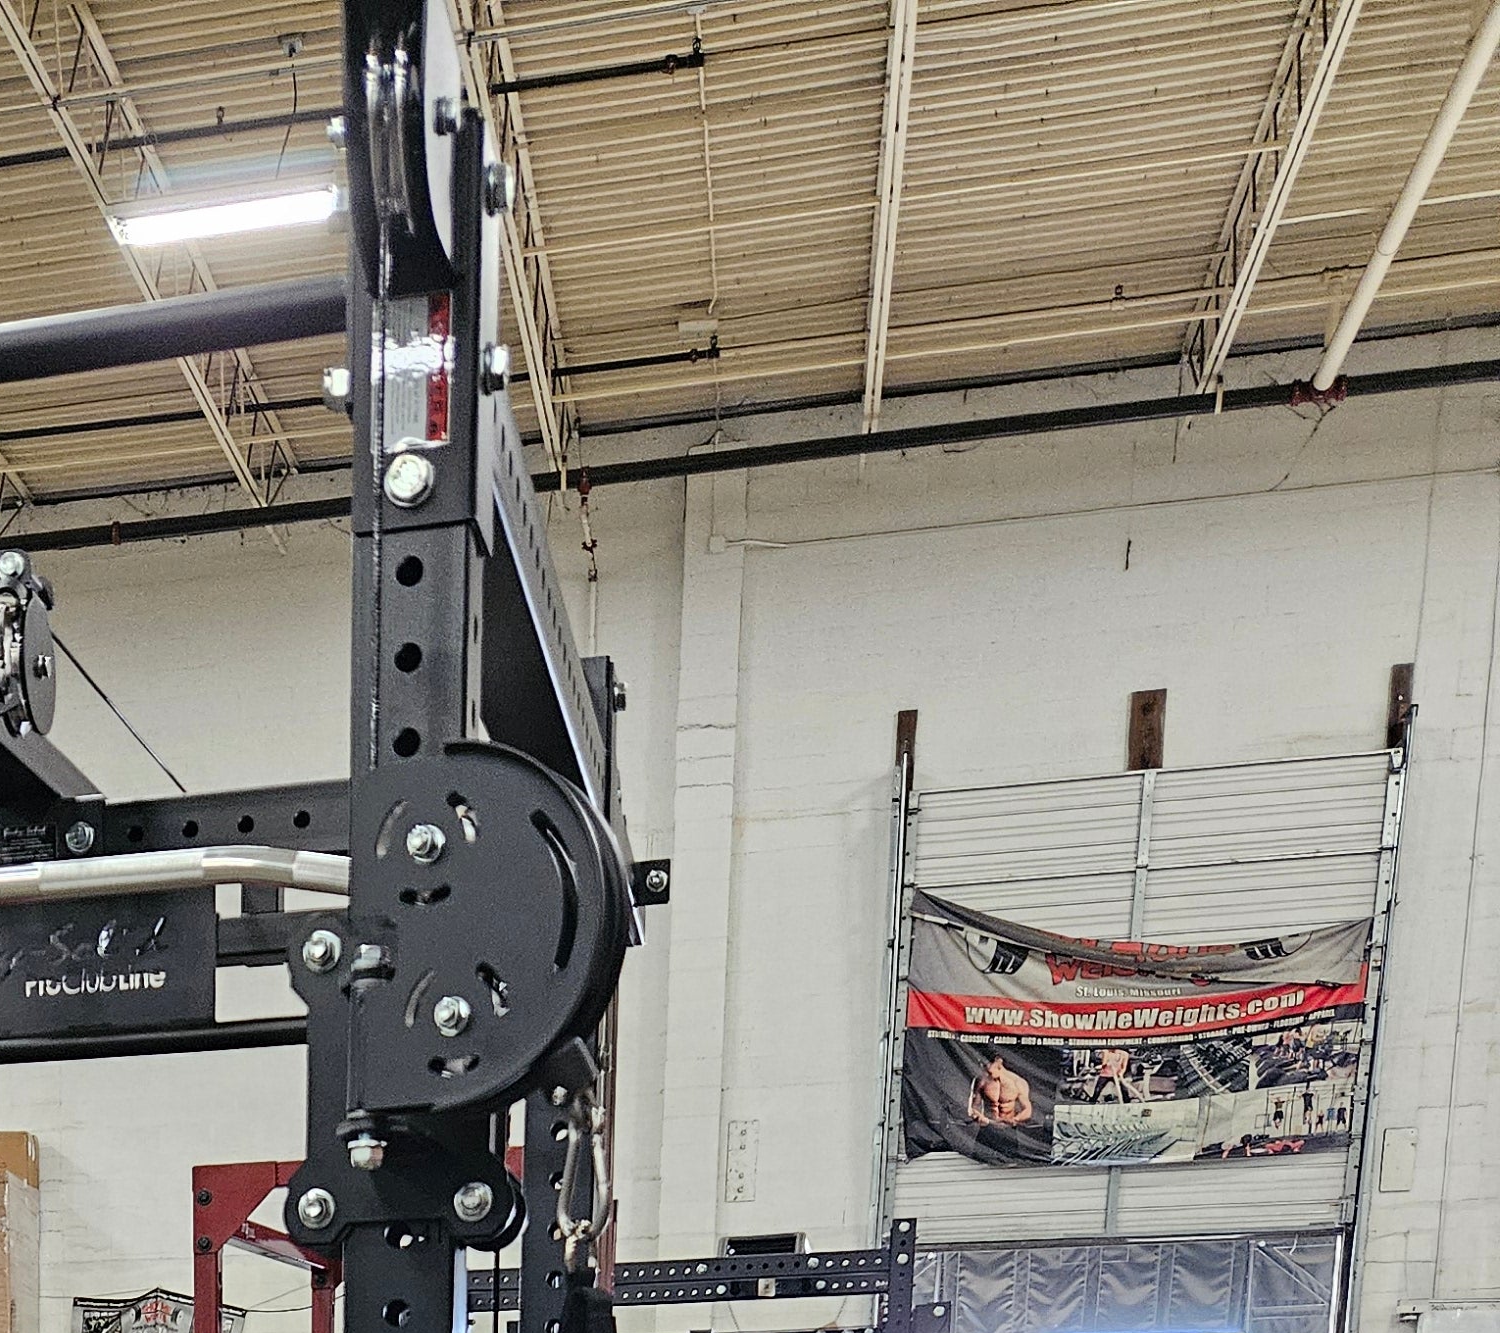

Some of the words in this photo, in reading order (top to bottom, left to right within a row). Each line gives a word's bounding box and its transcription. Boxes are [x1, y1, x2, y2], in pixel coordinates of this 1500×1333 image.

[1075, 985, 1091, 998] St.
[1129, 987, 1182, 997] Missouri
[965, 990, 1305, 1029] www.ShowMeWeights.com
